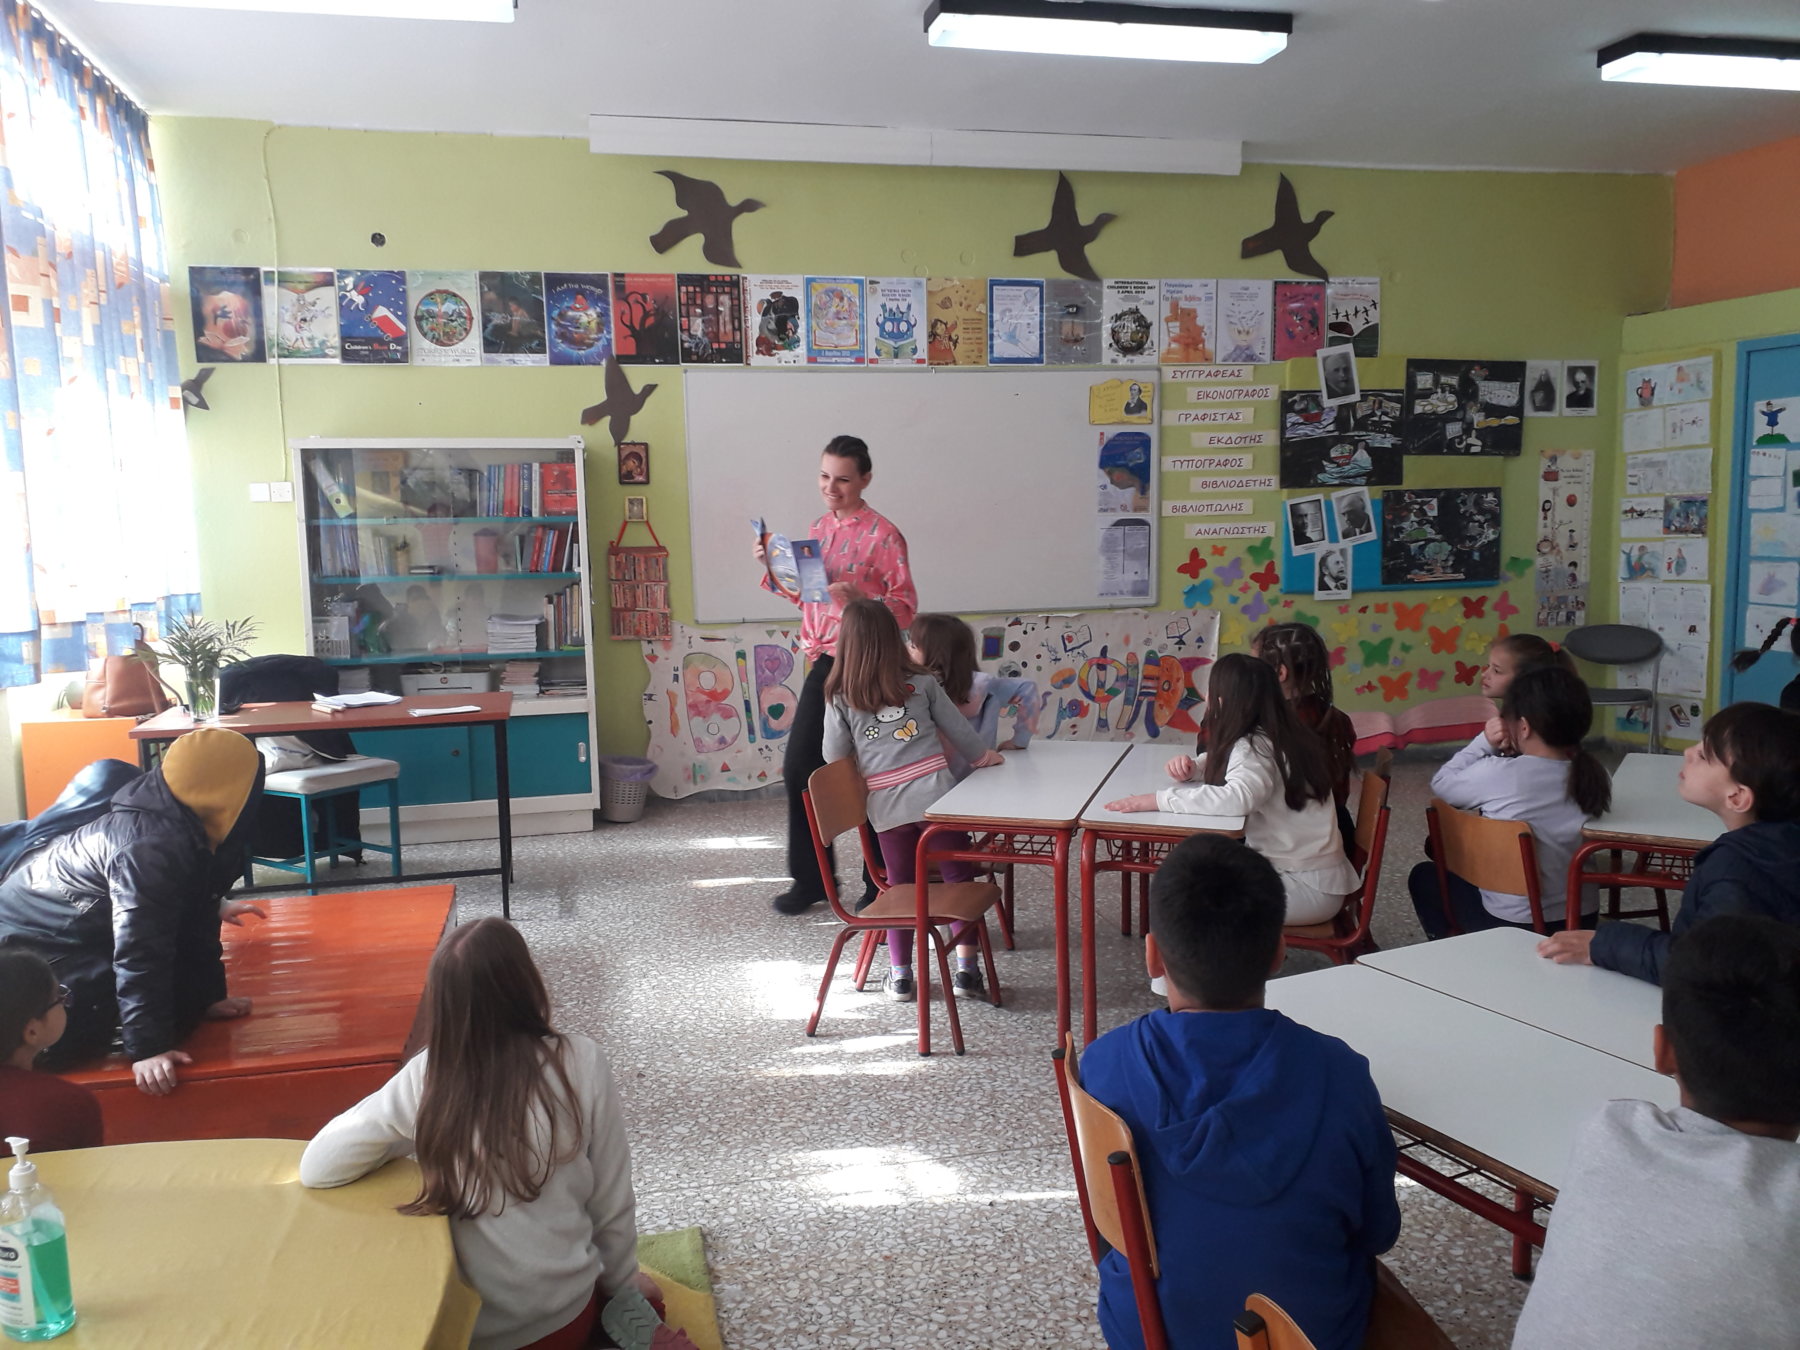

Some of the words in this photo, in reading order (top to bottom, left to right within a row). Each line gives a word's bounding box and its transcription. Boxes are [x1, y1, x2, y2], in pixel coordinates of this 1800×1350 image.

[1171, 369, 1243, 379] ΣΥΓΓΡΑΦΕΑΣ
[1196, 388, 1271, 400] ΕΙΚΟΝΟΓΡΑΦΟΣ
[1178, 411, 1243, 422] ΓΡΑΦΙΣΤΑΣ
[1208, 434, 1264, 445] ΕΚΔΟΤΗΣ
[1171, 458, 1244, 469] ΤΥΠΟΓΡΑΦΟΣ
[1201, 478, 1273, 489] ΒΙΒΛΙΟΔΕΤΗΣ
[1171, 502, 1244, 513] ΒΙΒΛΙΟΠΩΛΗΣ
[1195, 525, 1267, 536] ΑΝΑΓΝΩΣΤΗΣ
